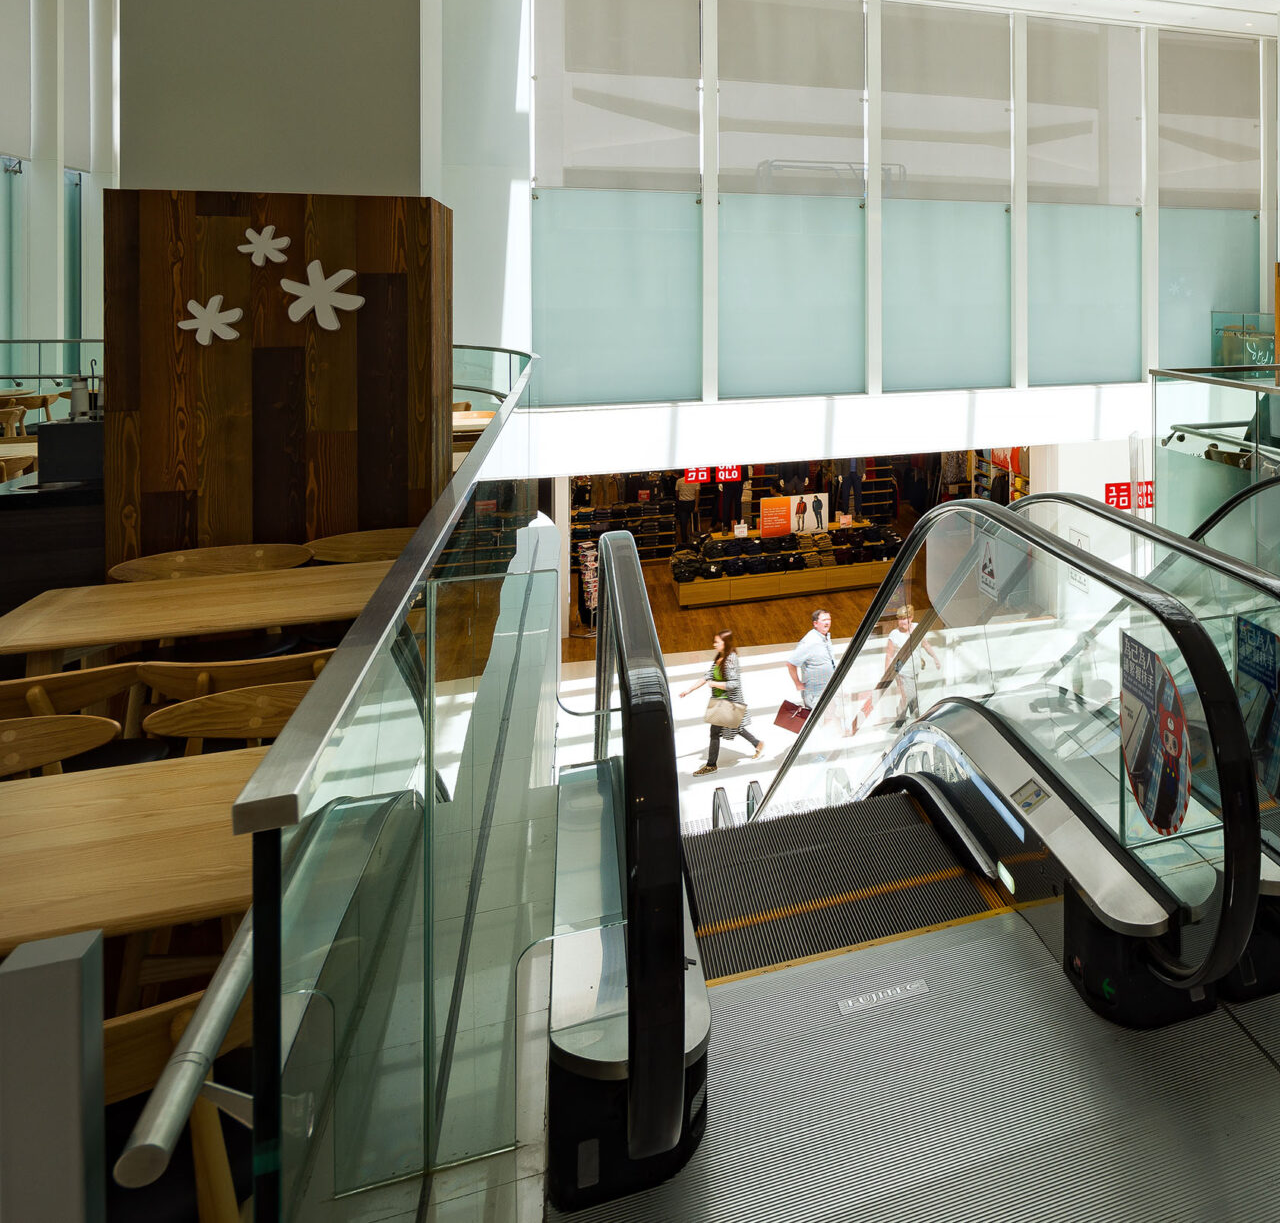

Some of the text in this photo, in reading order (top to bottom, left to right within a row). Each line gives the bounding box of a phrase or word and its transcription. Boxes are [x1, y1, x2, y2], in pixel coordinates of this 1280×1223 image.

[718, 470, 738, 480] QLO
[1108, 486, 1128, 496] ユニ
[1108, 496, 1129, 507] クロ
